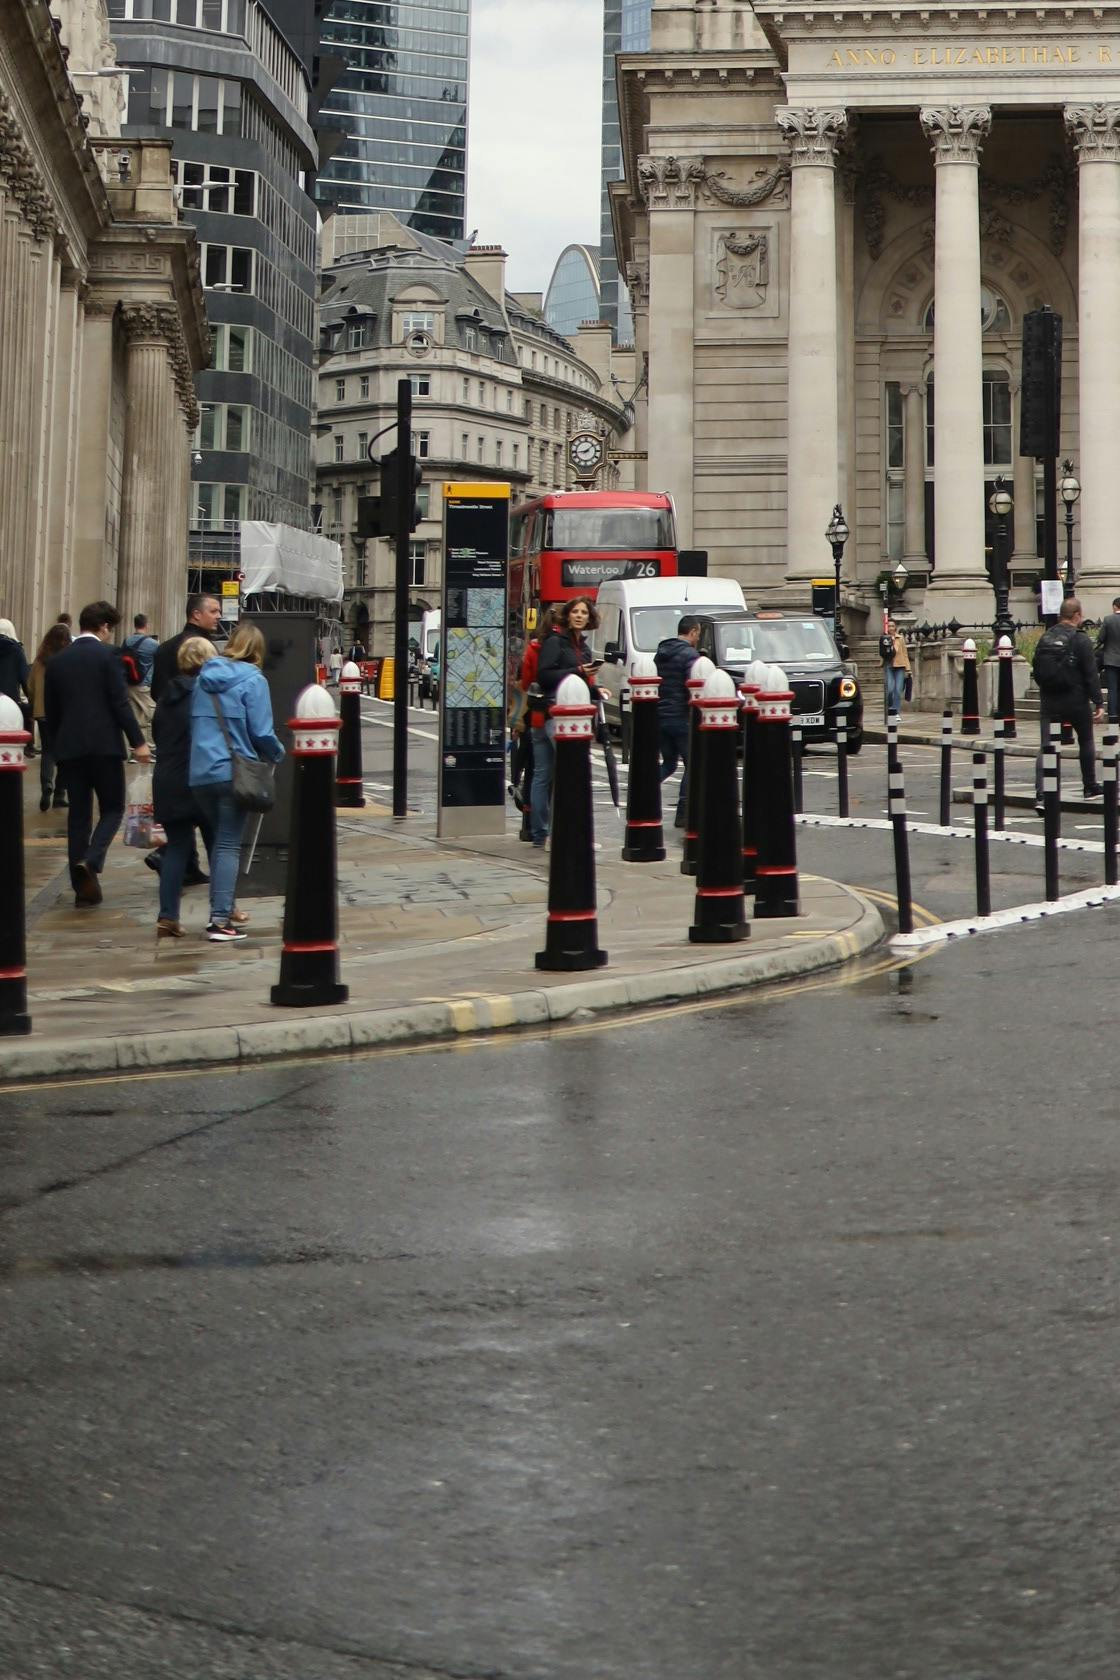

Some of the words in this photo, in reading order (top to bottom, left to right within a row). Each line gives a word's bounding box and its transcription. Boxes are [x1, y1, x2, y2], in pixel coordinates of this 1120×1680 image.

[827, 47, 897, 67] ANNO
[912, 45, 1081, 65] ELIZABETHAE
[1098, 45, 1113, 63] R
[567, 564, 620, 575] Waterloo
[636, 561, 656, 577] 26
